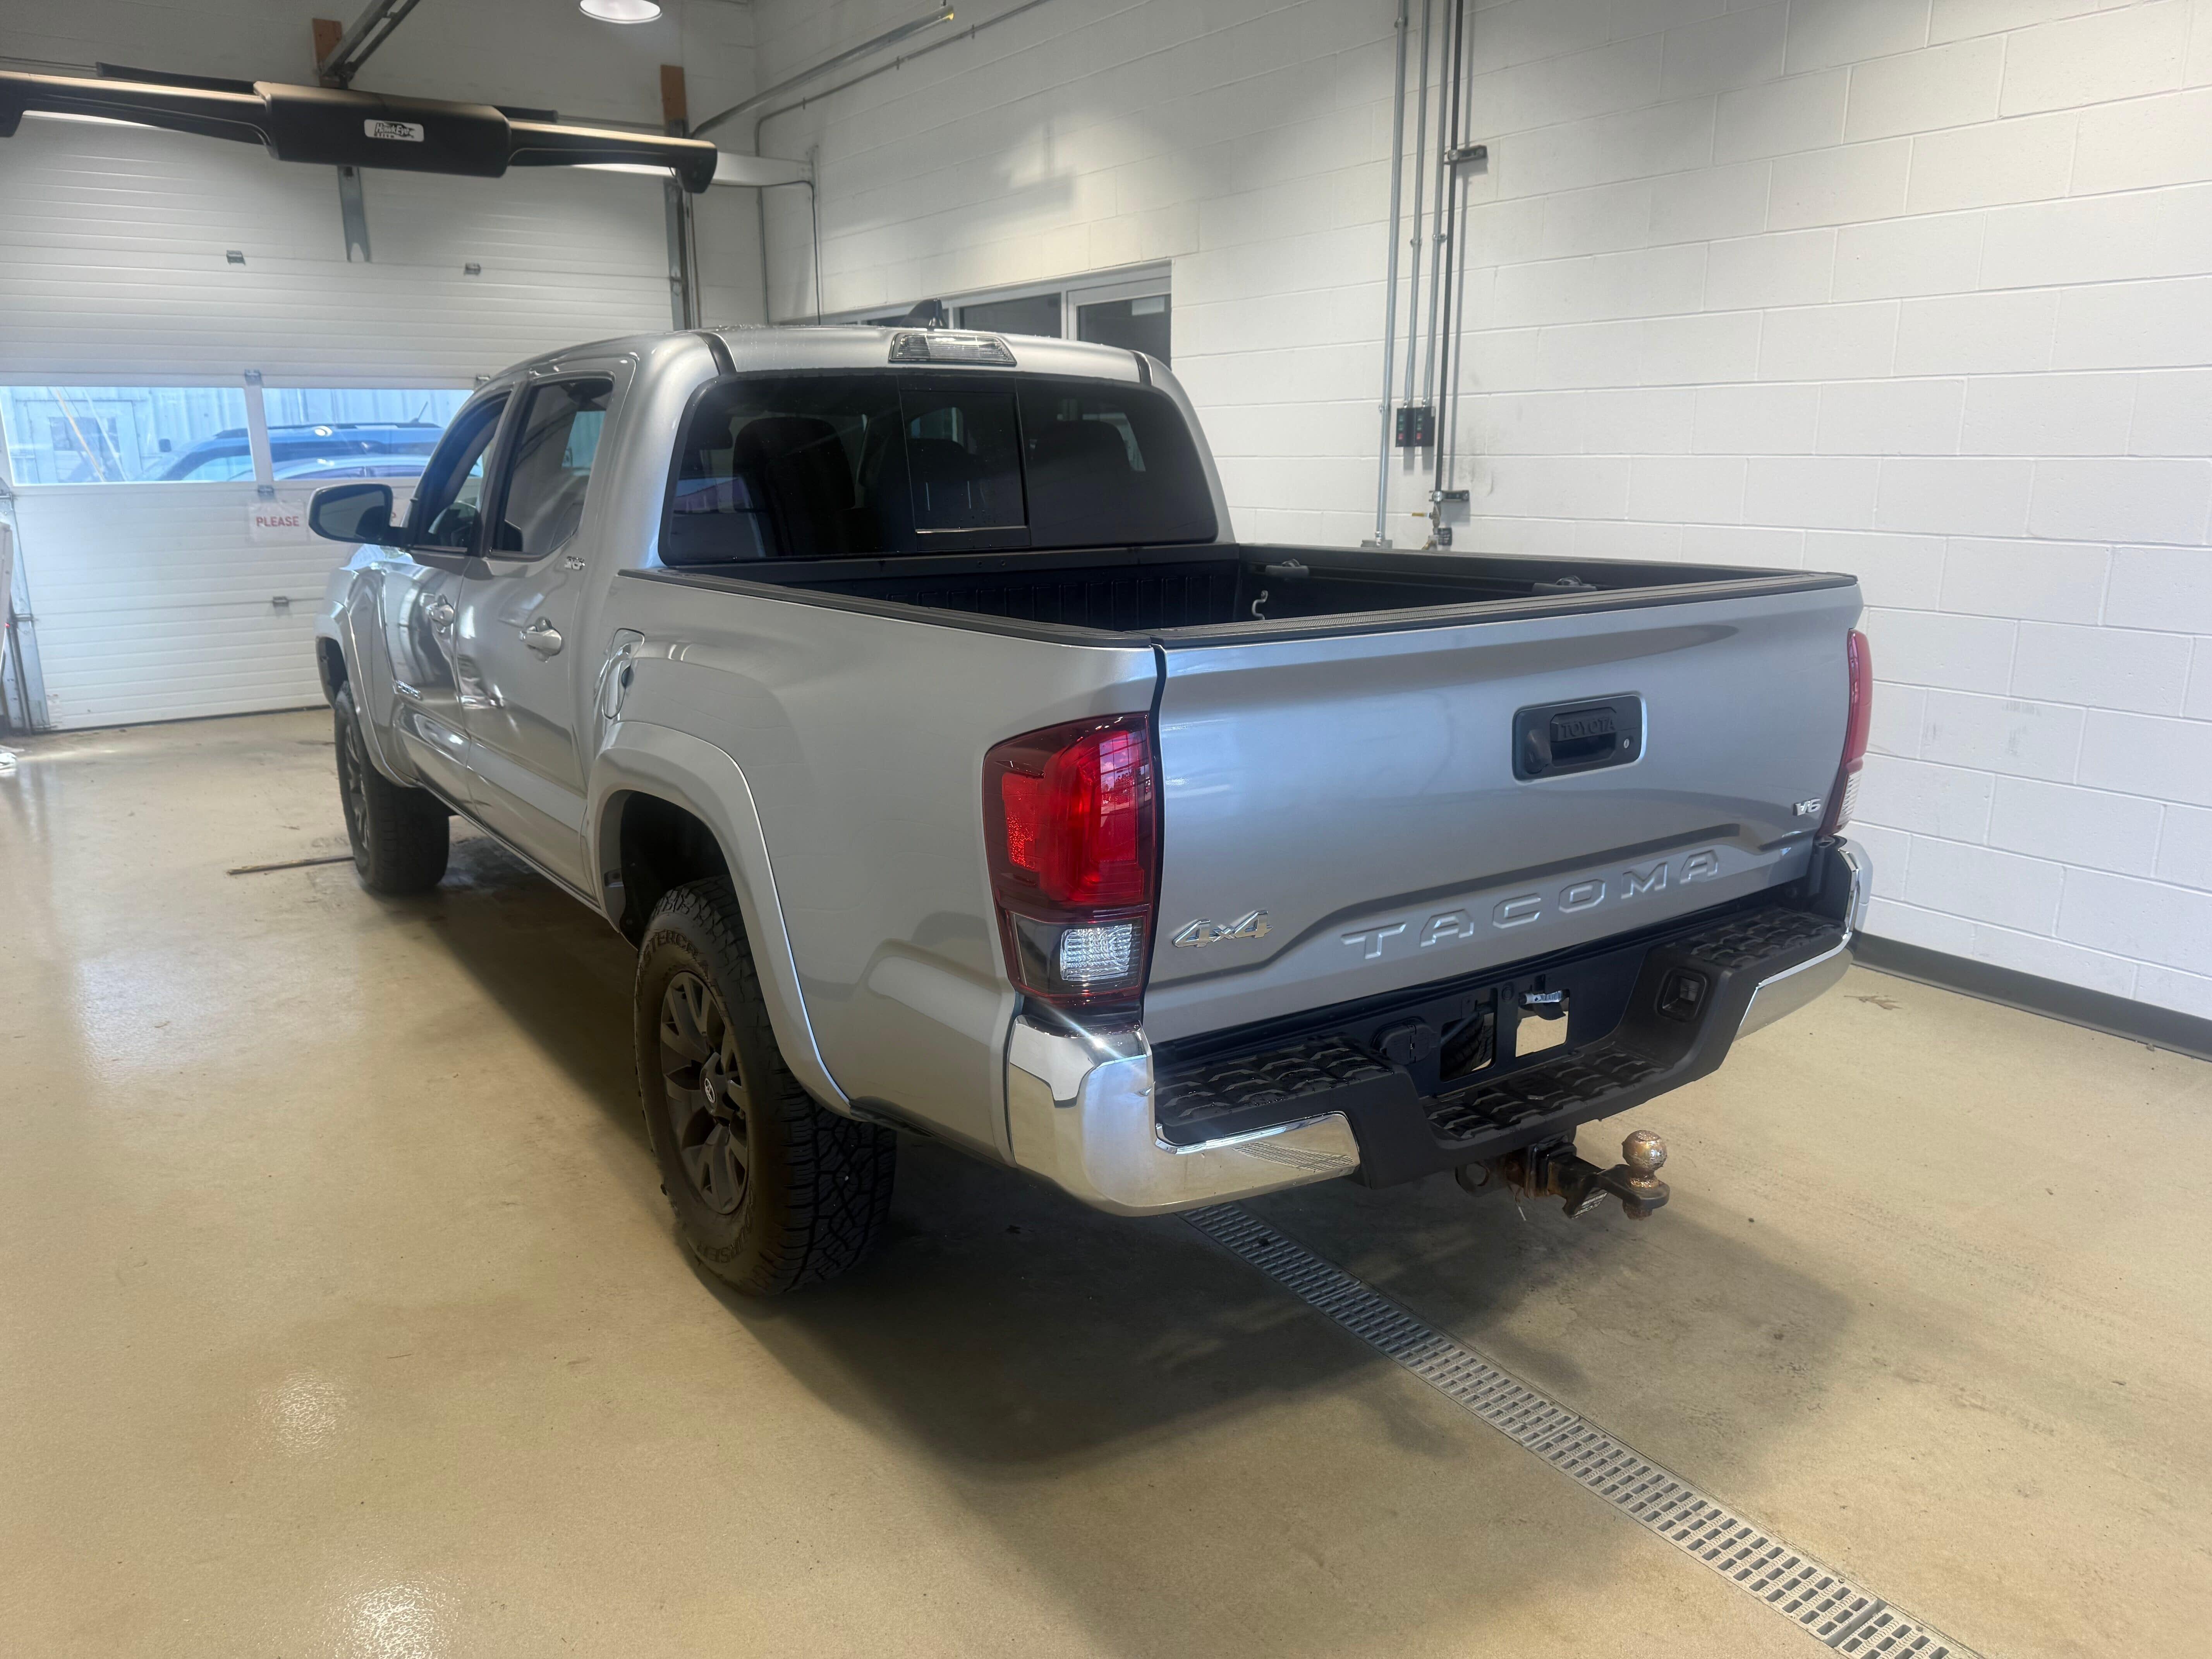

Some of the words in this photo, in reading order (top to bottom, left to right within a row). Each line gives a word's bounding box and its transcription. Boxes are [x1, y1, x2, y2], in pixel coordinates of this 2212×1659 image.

[376, 123, 409, 136] HawkEye
[256, 516, 300, 527] PLEASE
[1561, 717, 1616, 738] TOYOTA
[1793, 798, 1821, 816] V6
[1340, 850, 1719, 959] TACOMA
